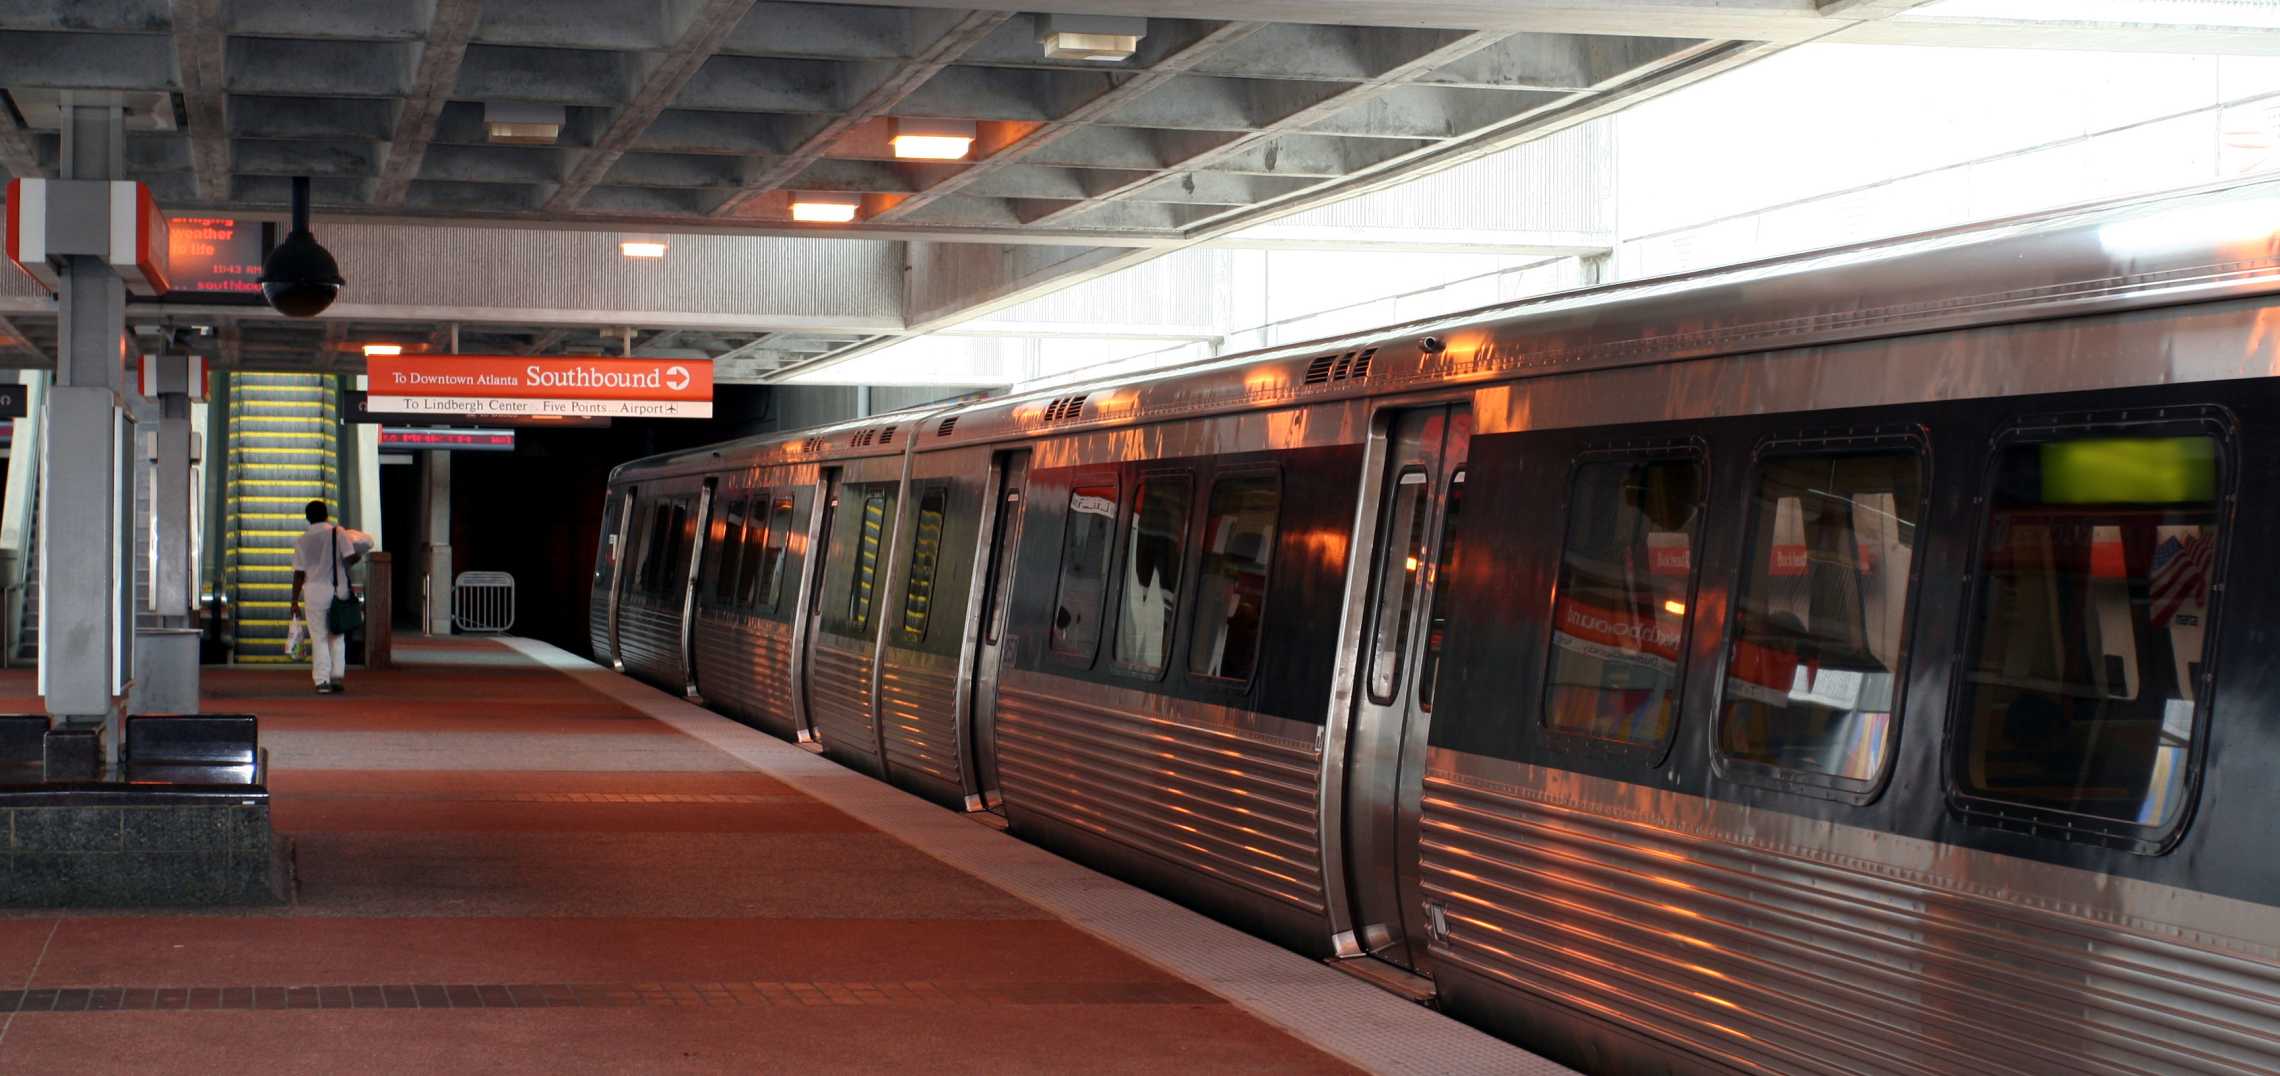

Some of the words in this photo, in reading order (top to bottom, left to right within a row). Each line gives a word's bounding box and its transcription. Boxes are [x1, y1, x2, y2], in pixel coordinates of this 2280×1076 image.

[191, 243, 215, 256] life
[392, 371, 407, 384] To
[410, 372, 474, 385] Downtown
[476, 373, 519, 386] Atlanta
[526, 365, 661, 388] Southbound
[403, 398, 419, 410] To
[424, 399, 484, 412] Lindbergh
[488, 399, 528, 411] Center
[543, 401, 566, 412] Five
[571, 401, 607, 413] Points
[620, 402, 664, 415] Airport
